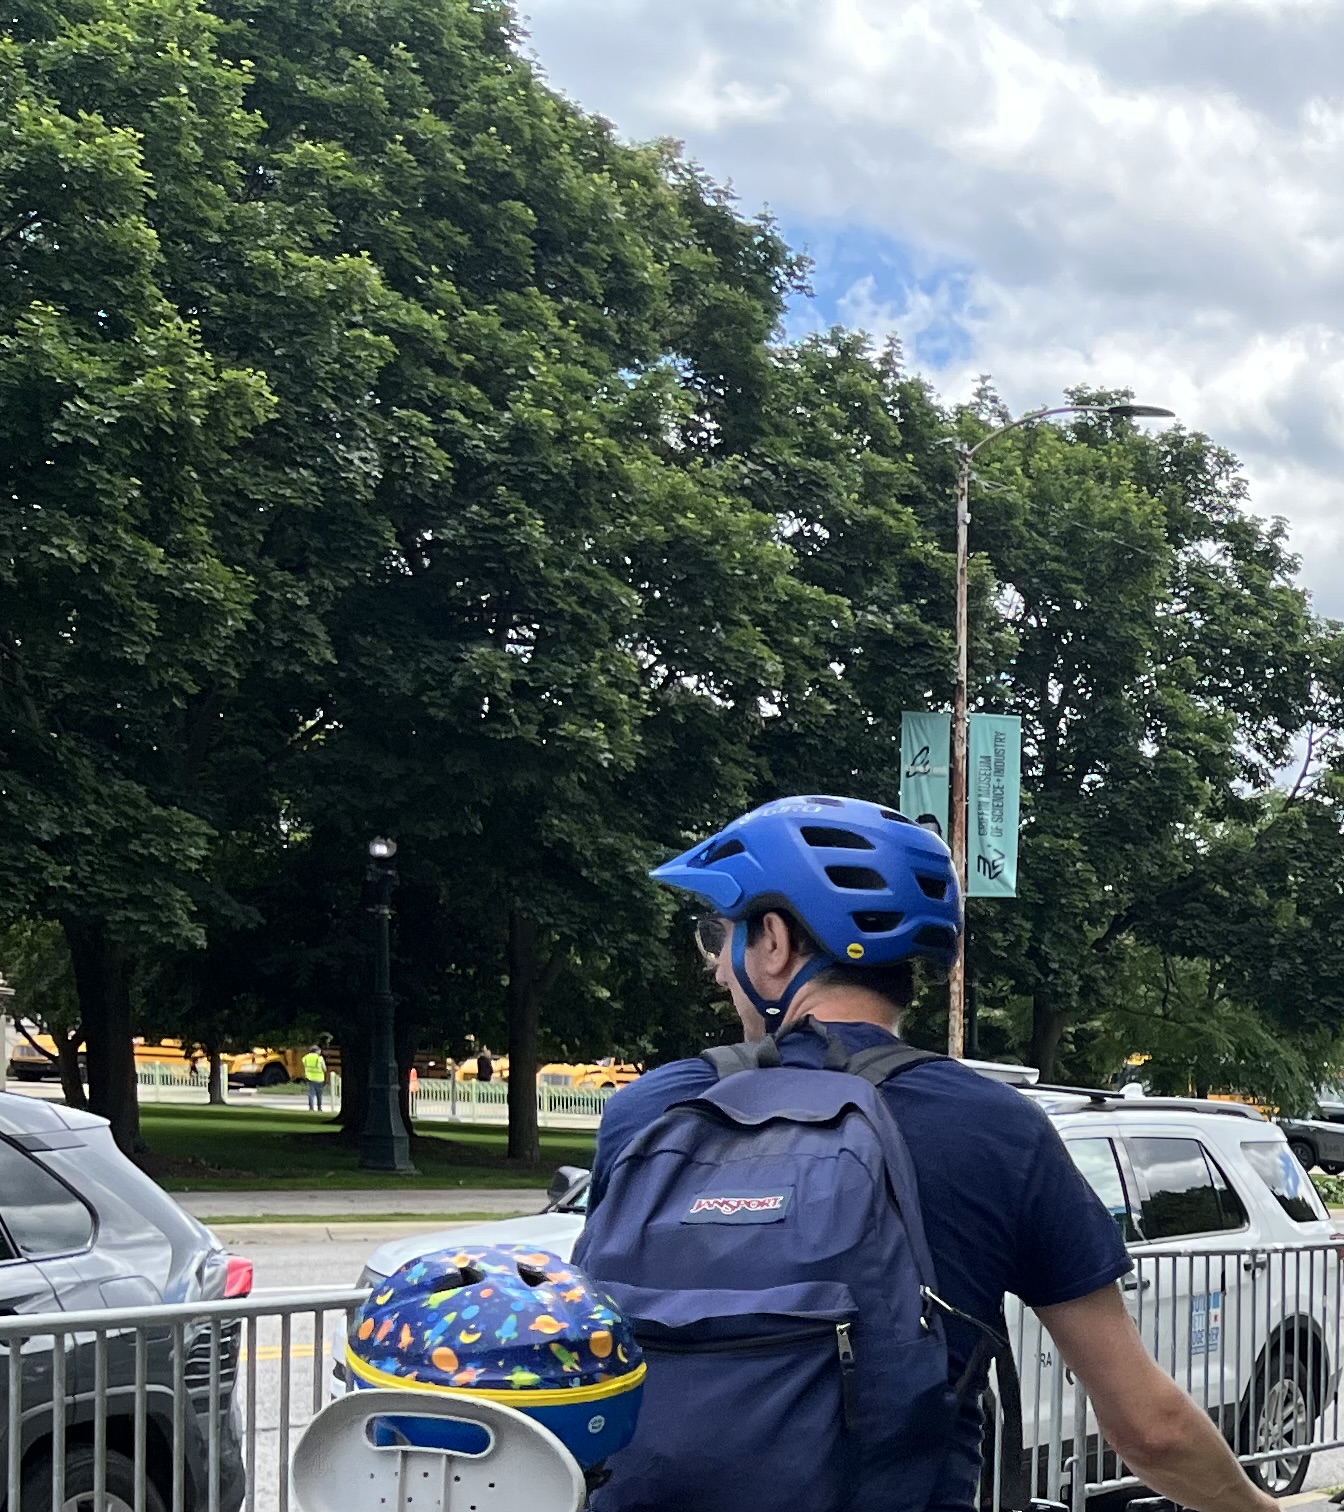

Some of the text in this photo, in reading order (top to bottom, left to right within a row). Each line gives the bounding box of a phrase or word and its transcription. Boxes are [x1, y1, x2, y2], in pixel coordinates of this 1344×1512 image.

[993, 731, 1006, 778] INDUSTRY
[978, 756, 992, 798] MUSEUM
[991, 784, 1005, 823] SCIENCE
[990, 822, 1003, 838] OF
[690, 1196, 784, 1215] JANSPORT
